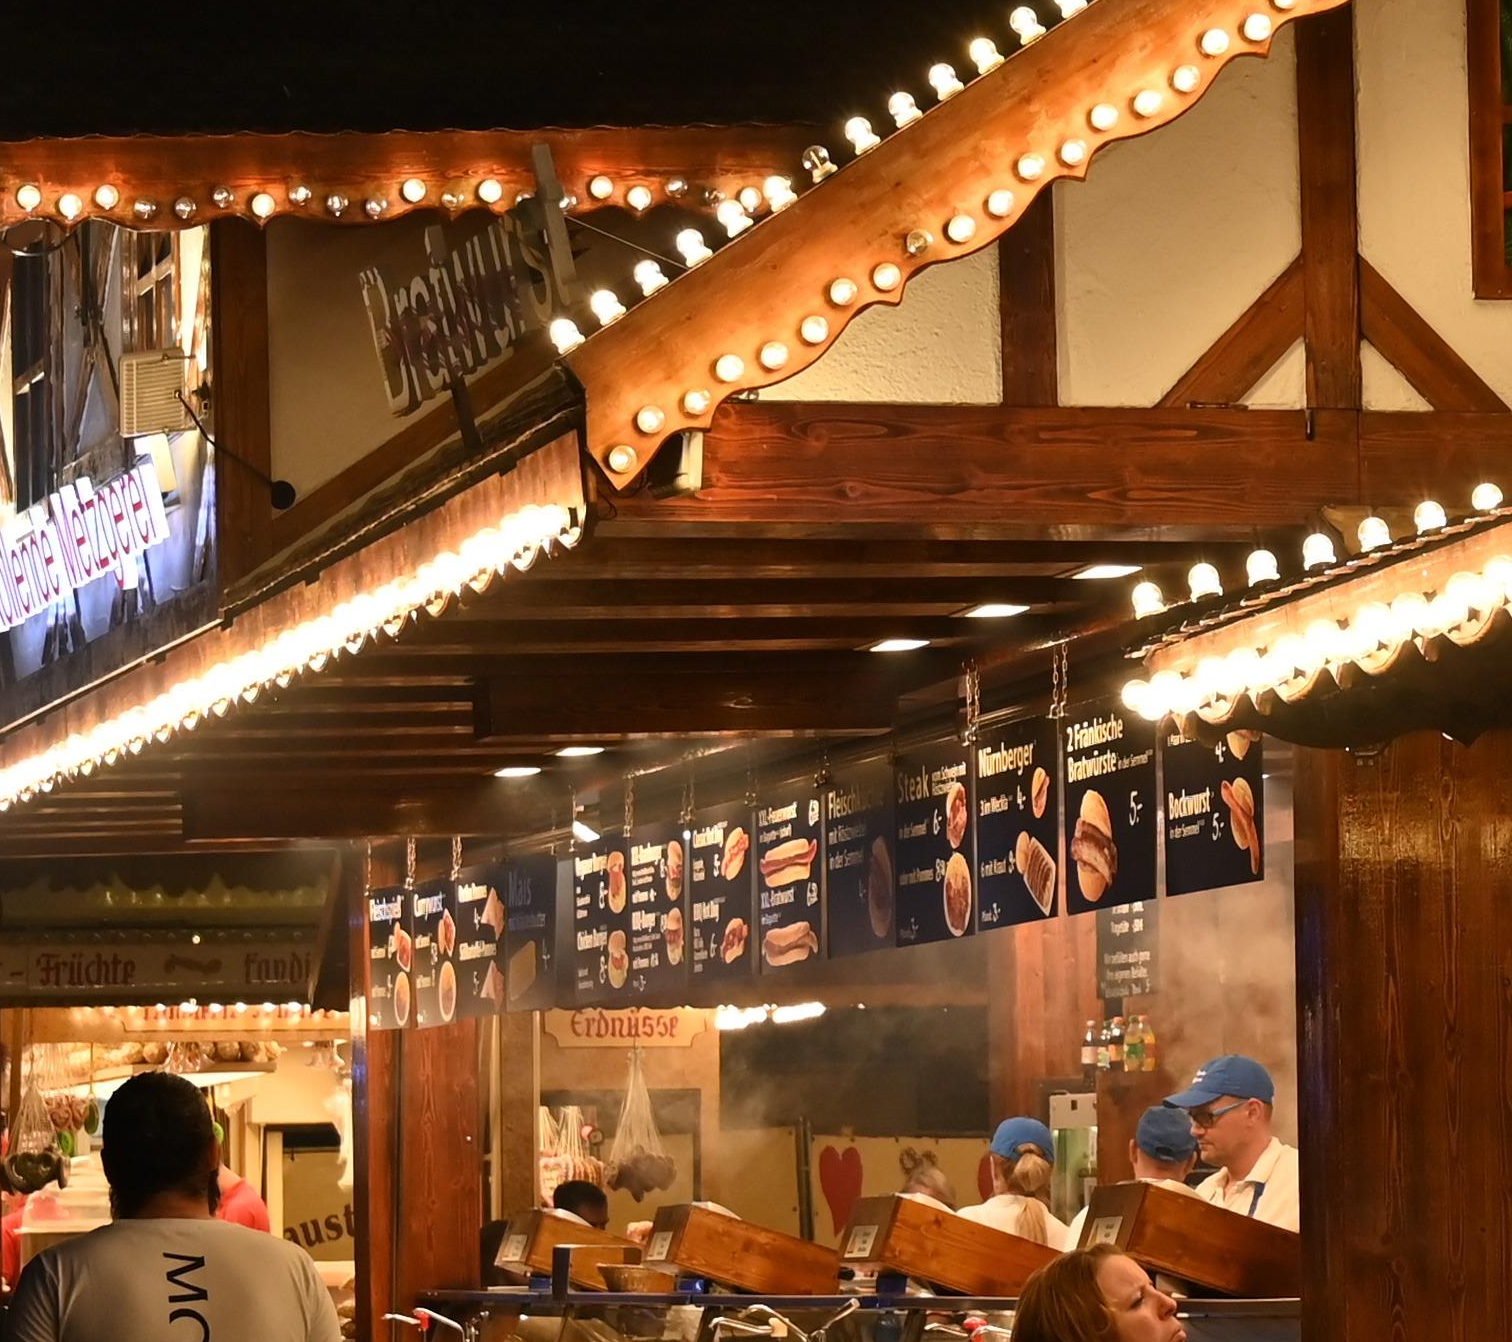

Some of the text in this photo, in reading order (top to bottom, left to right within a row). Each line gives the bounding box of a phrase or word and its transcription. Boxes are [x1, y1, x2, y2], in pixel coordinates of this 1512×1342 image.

[49, 454, 170, 590] Metzgerei
[1067, 713, 1123, 752] 2 Fränkische
[978, 742, 1034, 778] Nürnberger
[1067, 749, 1117, 783] Bratwürste
[898, 765, 930, 803] Steak
[1168, 787, 1211, 820] Bockwurst
[35, 953, 136, 988] Früchte
[570, 1008, 679, 1038] Erdnüsse
